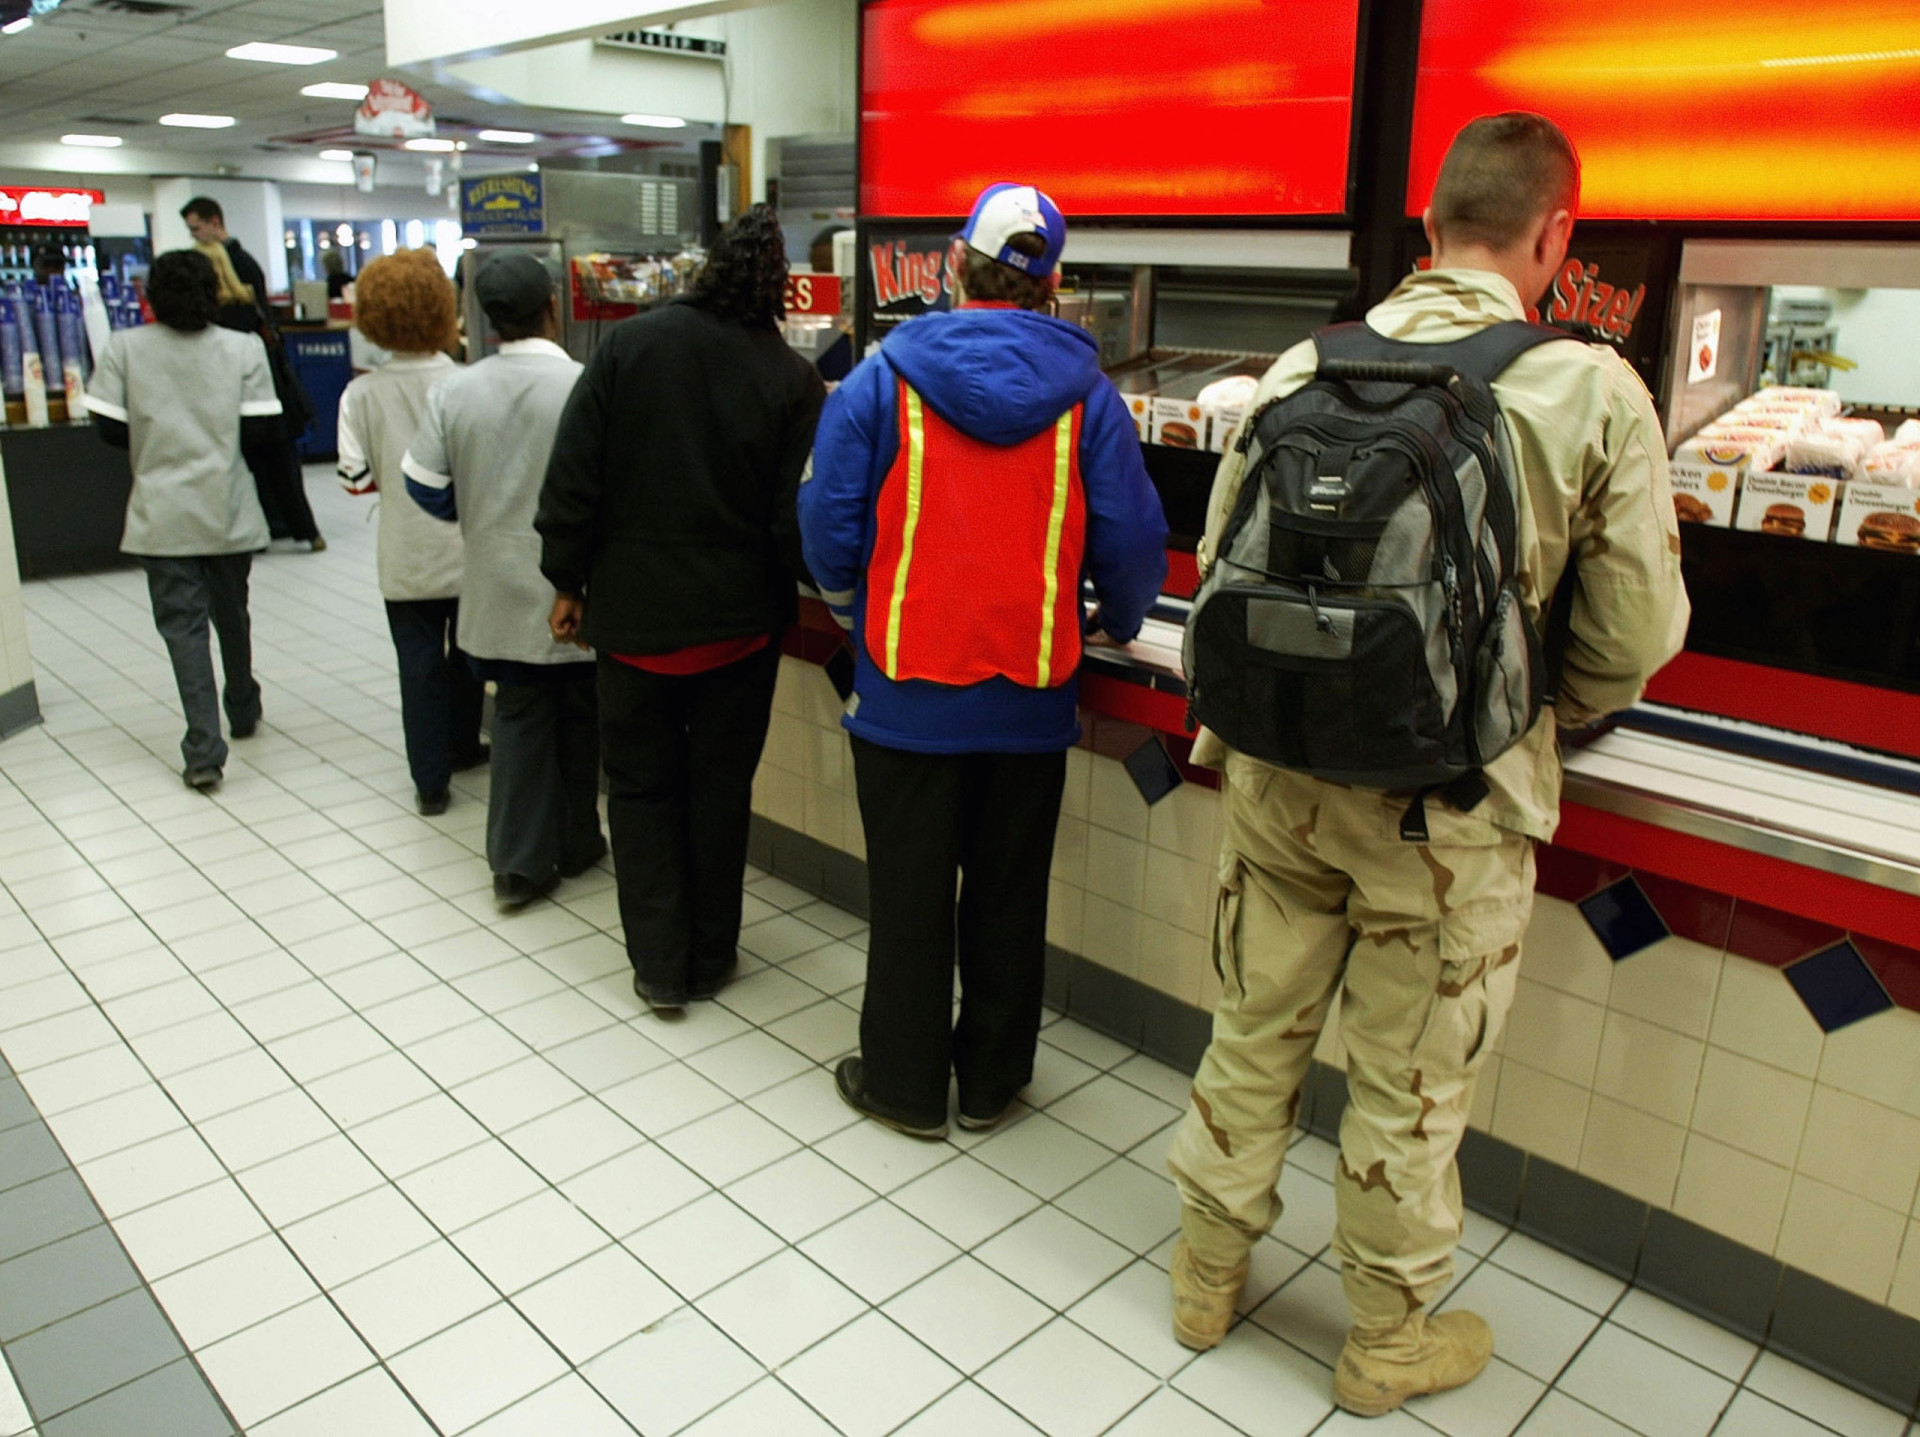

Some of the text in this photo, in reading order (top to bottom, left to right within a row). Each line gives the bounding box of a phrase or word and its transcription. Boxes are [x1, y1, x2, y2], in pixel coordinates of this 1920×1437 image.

[1008, 251, 1029, 269] USA
[869, 240, 941, 306] King
[1548, 258, 1646, 344] Size!
[1746, 484, 1804, 498] Cheeseburger
[1749, 476, 1806, 489] Double Bacon
